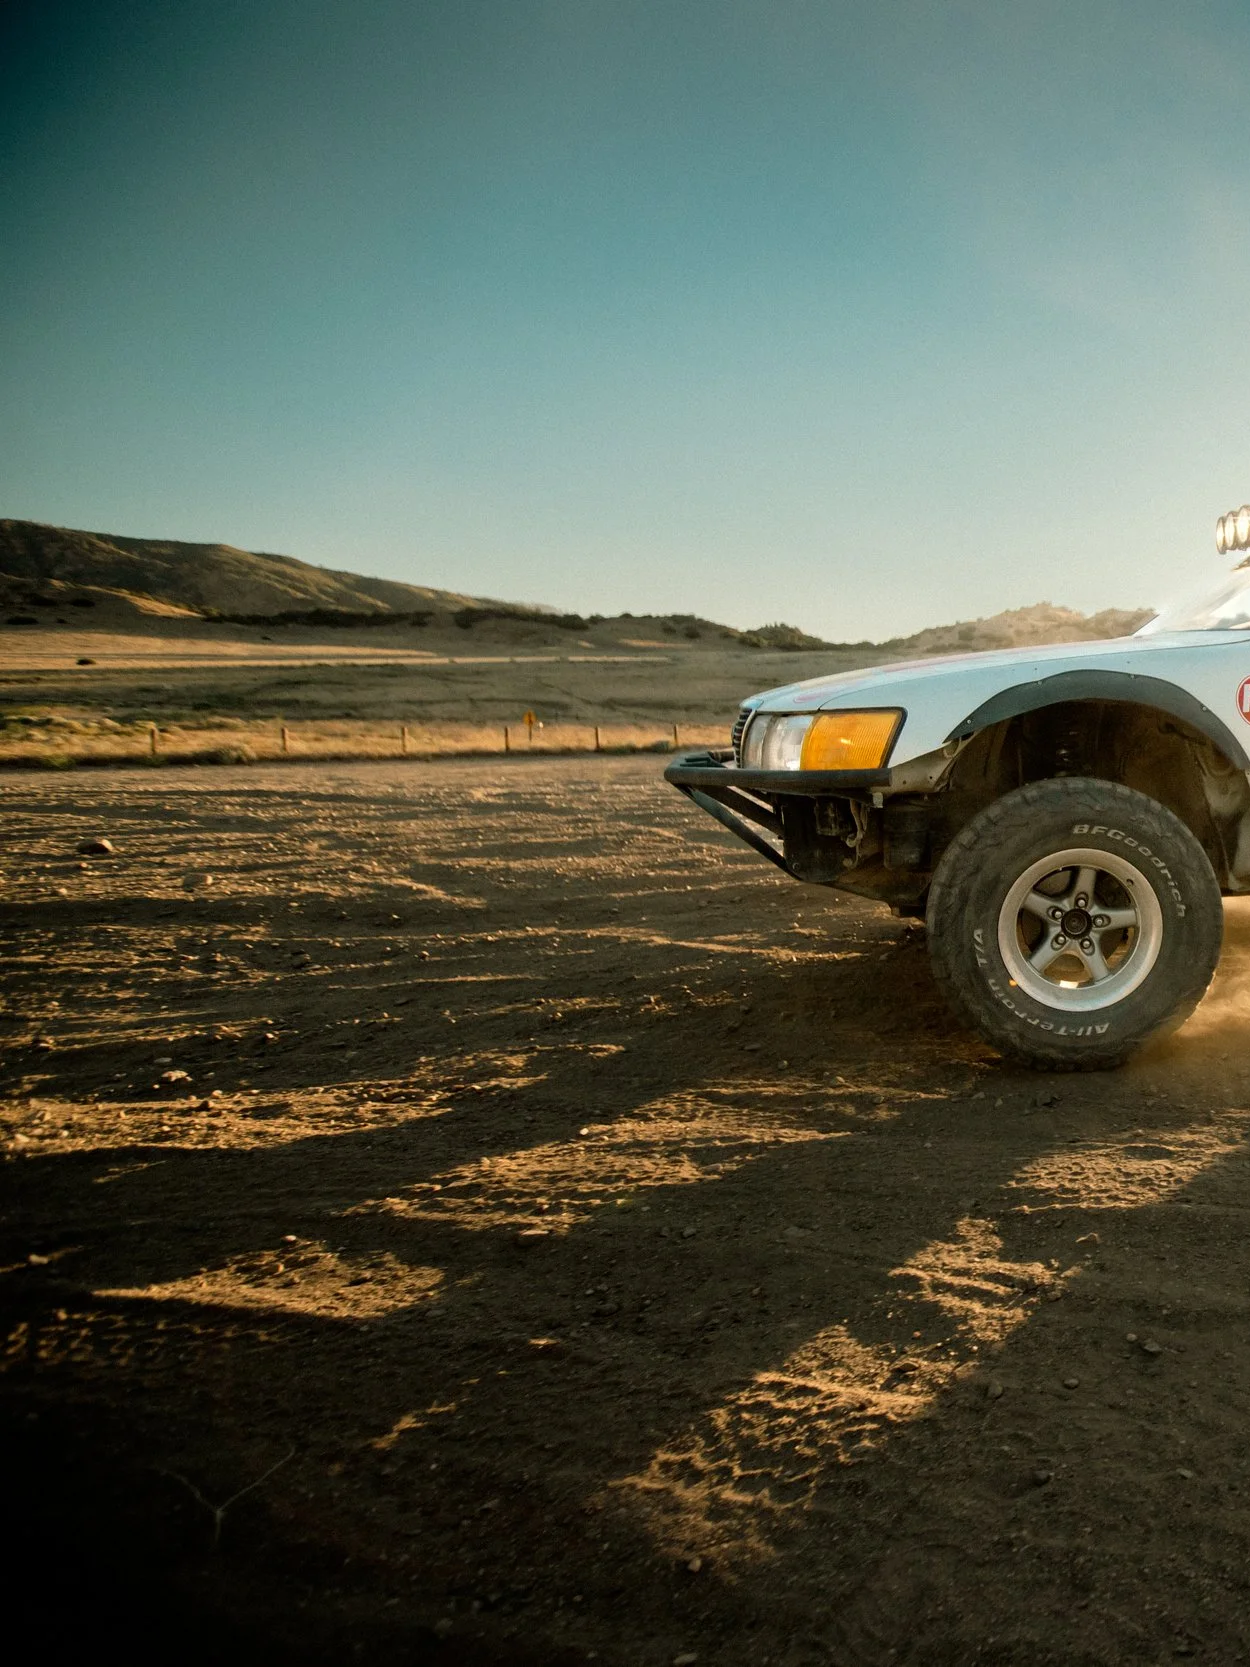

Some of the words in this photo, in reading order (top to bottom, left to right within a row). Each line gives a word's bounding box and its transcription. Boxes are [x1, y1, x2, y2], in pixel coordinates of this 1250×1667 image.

[1072, 823, 1187, 918] BFGoodrich
[972, 928, 991, 968] T/A
[987, 978, 1111, 1037] All-Terrain
